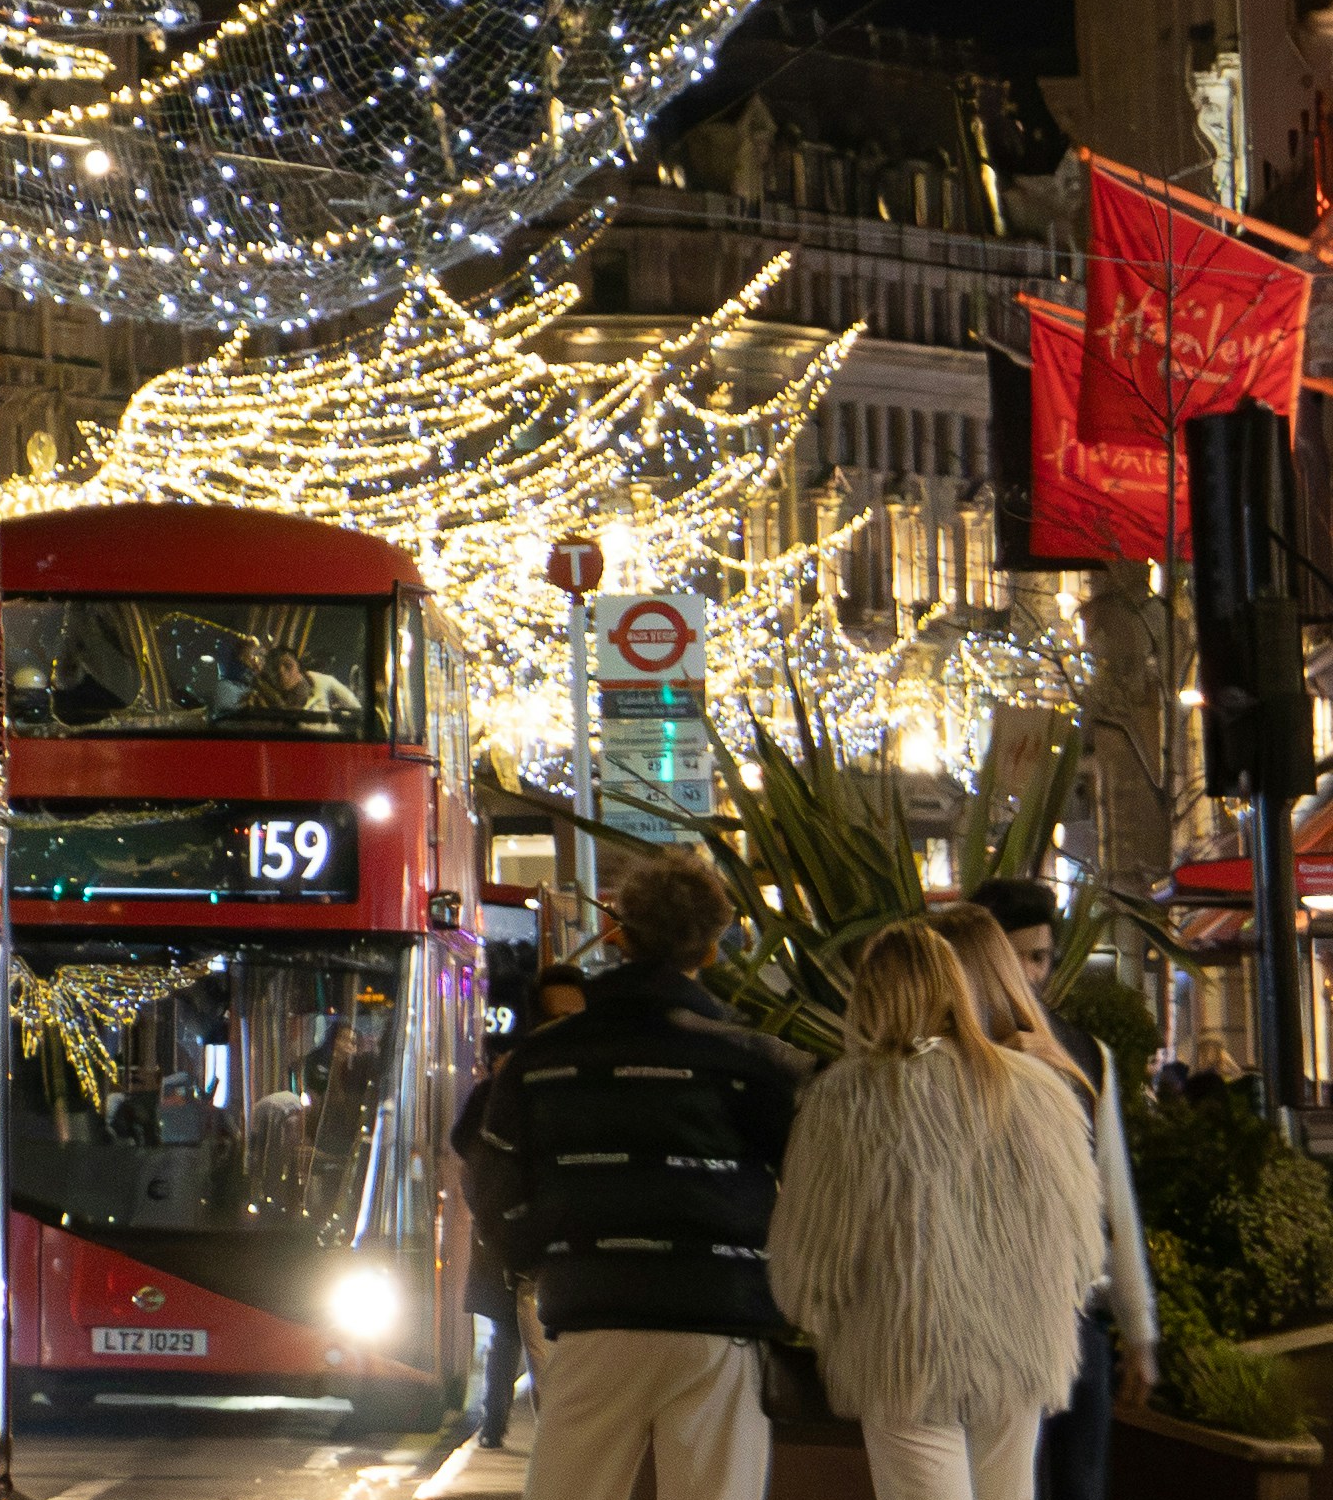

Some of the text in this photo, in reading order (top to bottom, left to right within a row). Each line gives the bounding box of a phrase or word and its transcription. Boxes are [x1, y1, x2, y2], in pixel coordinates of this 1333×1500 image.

[559, 544, 593, 587] T
[248, 820, 330, 880] 159
[103, 1331, 194, 1352] LTZ 1029
